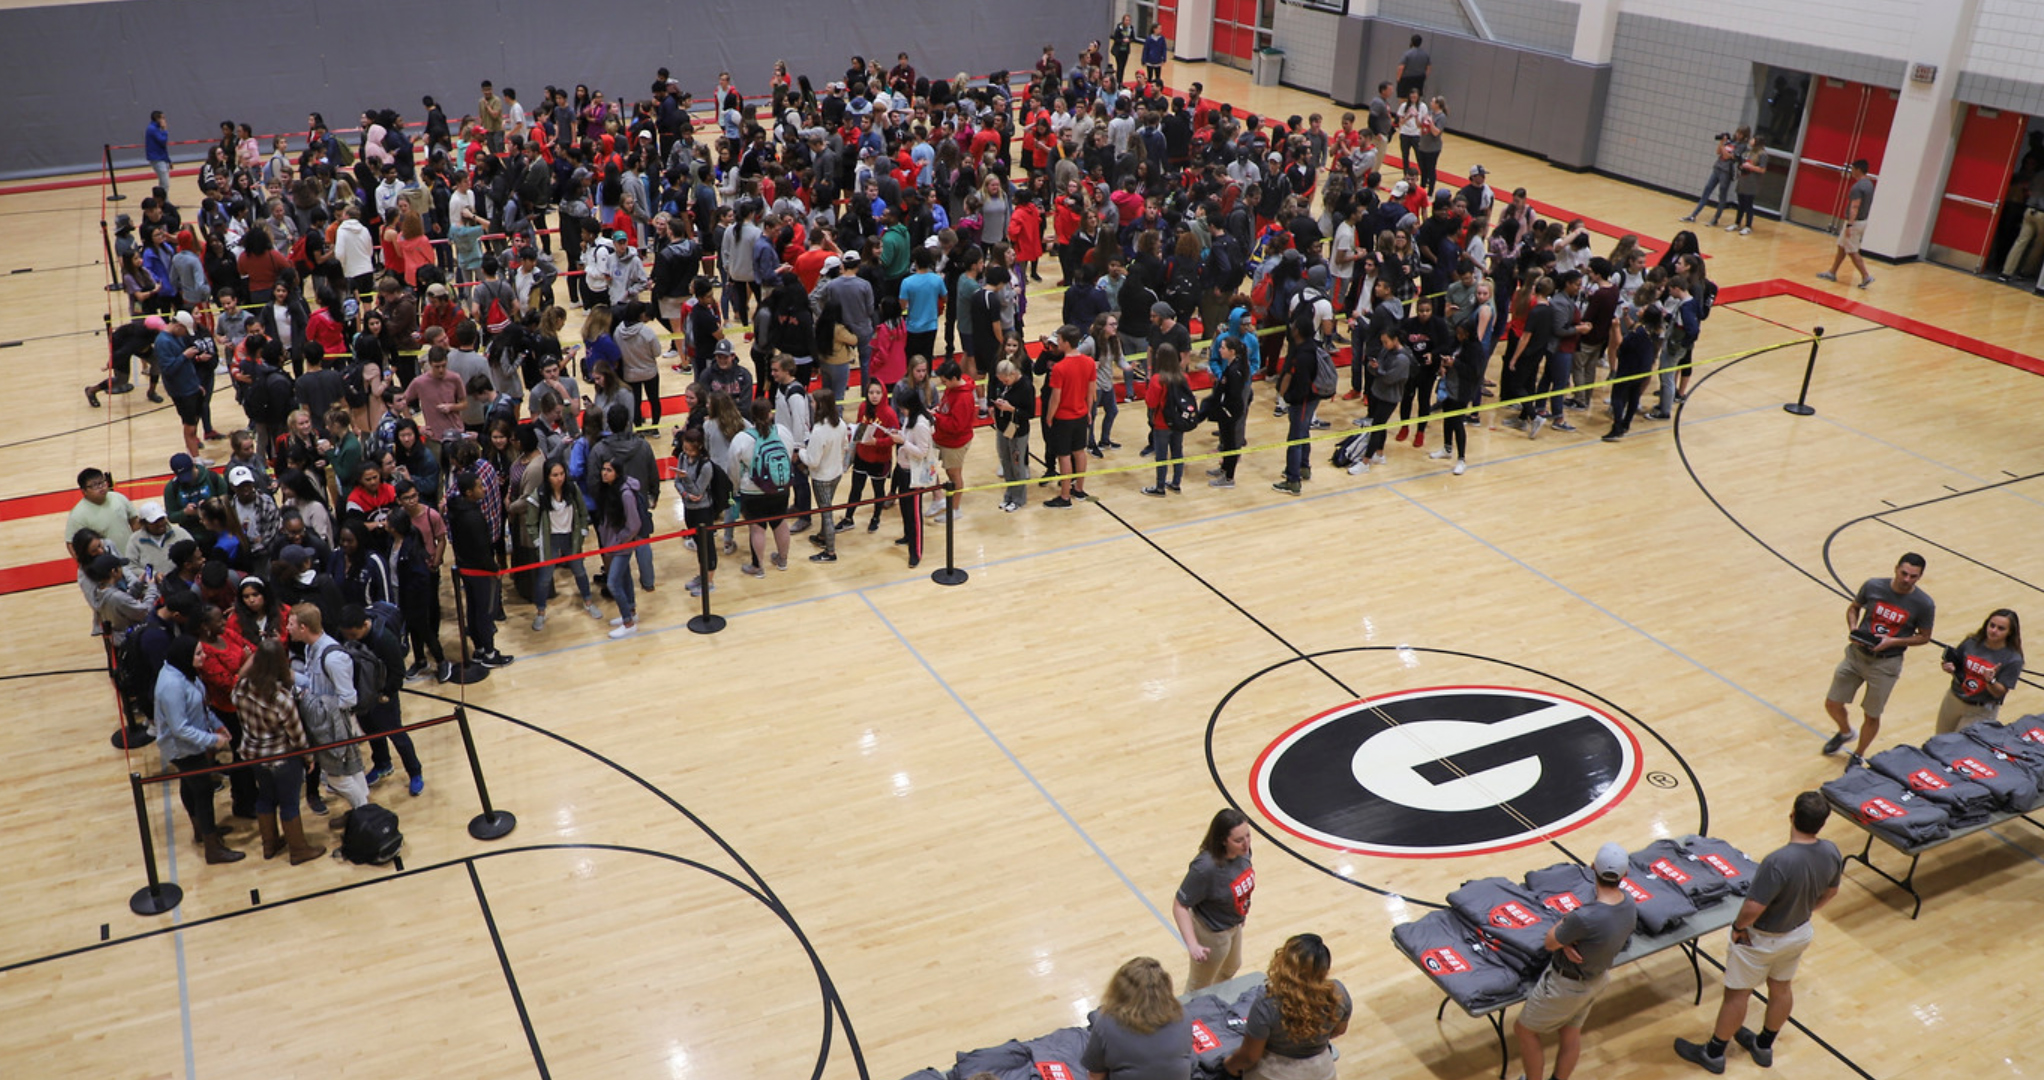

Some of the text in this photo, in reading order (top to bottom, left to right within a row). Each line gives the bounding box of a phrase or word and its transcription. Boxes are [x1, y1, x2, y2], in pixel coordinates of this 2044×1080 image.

[1875, 605, 1905, 623] BEAT
[1966, 659, 1985, 675] BEA
[2031, 731, 2044, 744] BE
[1269, 694, 1624, 848] G
[1963, 759, 1994, 776] BEAT
[1656, 861, 1687, 881] BEAT
[1706, 855, 1735, 875] BEAT
[1559, 896, 1576, 911] BE
[1505, 904, 1535, 924] BEAT
[1439, 949, 1466, 971] BEAT
[1050, 1065, 1066, 1080] BE
